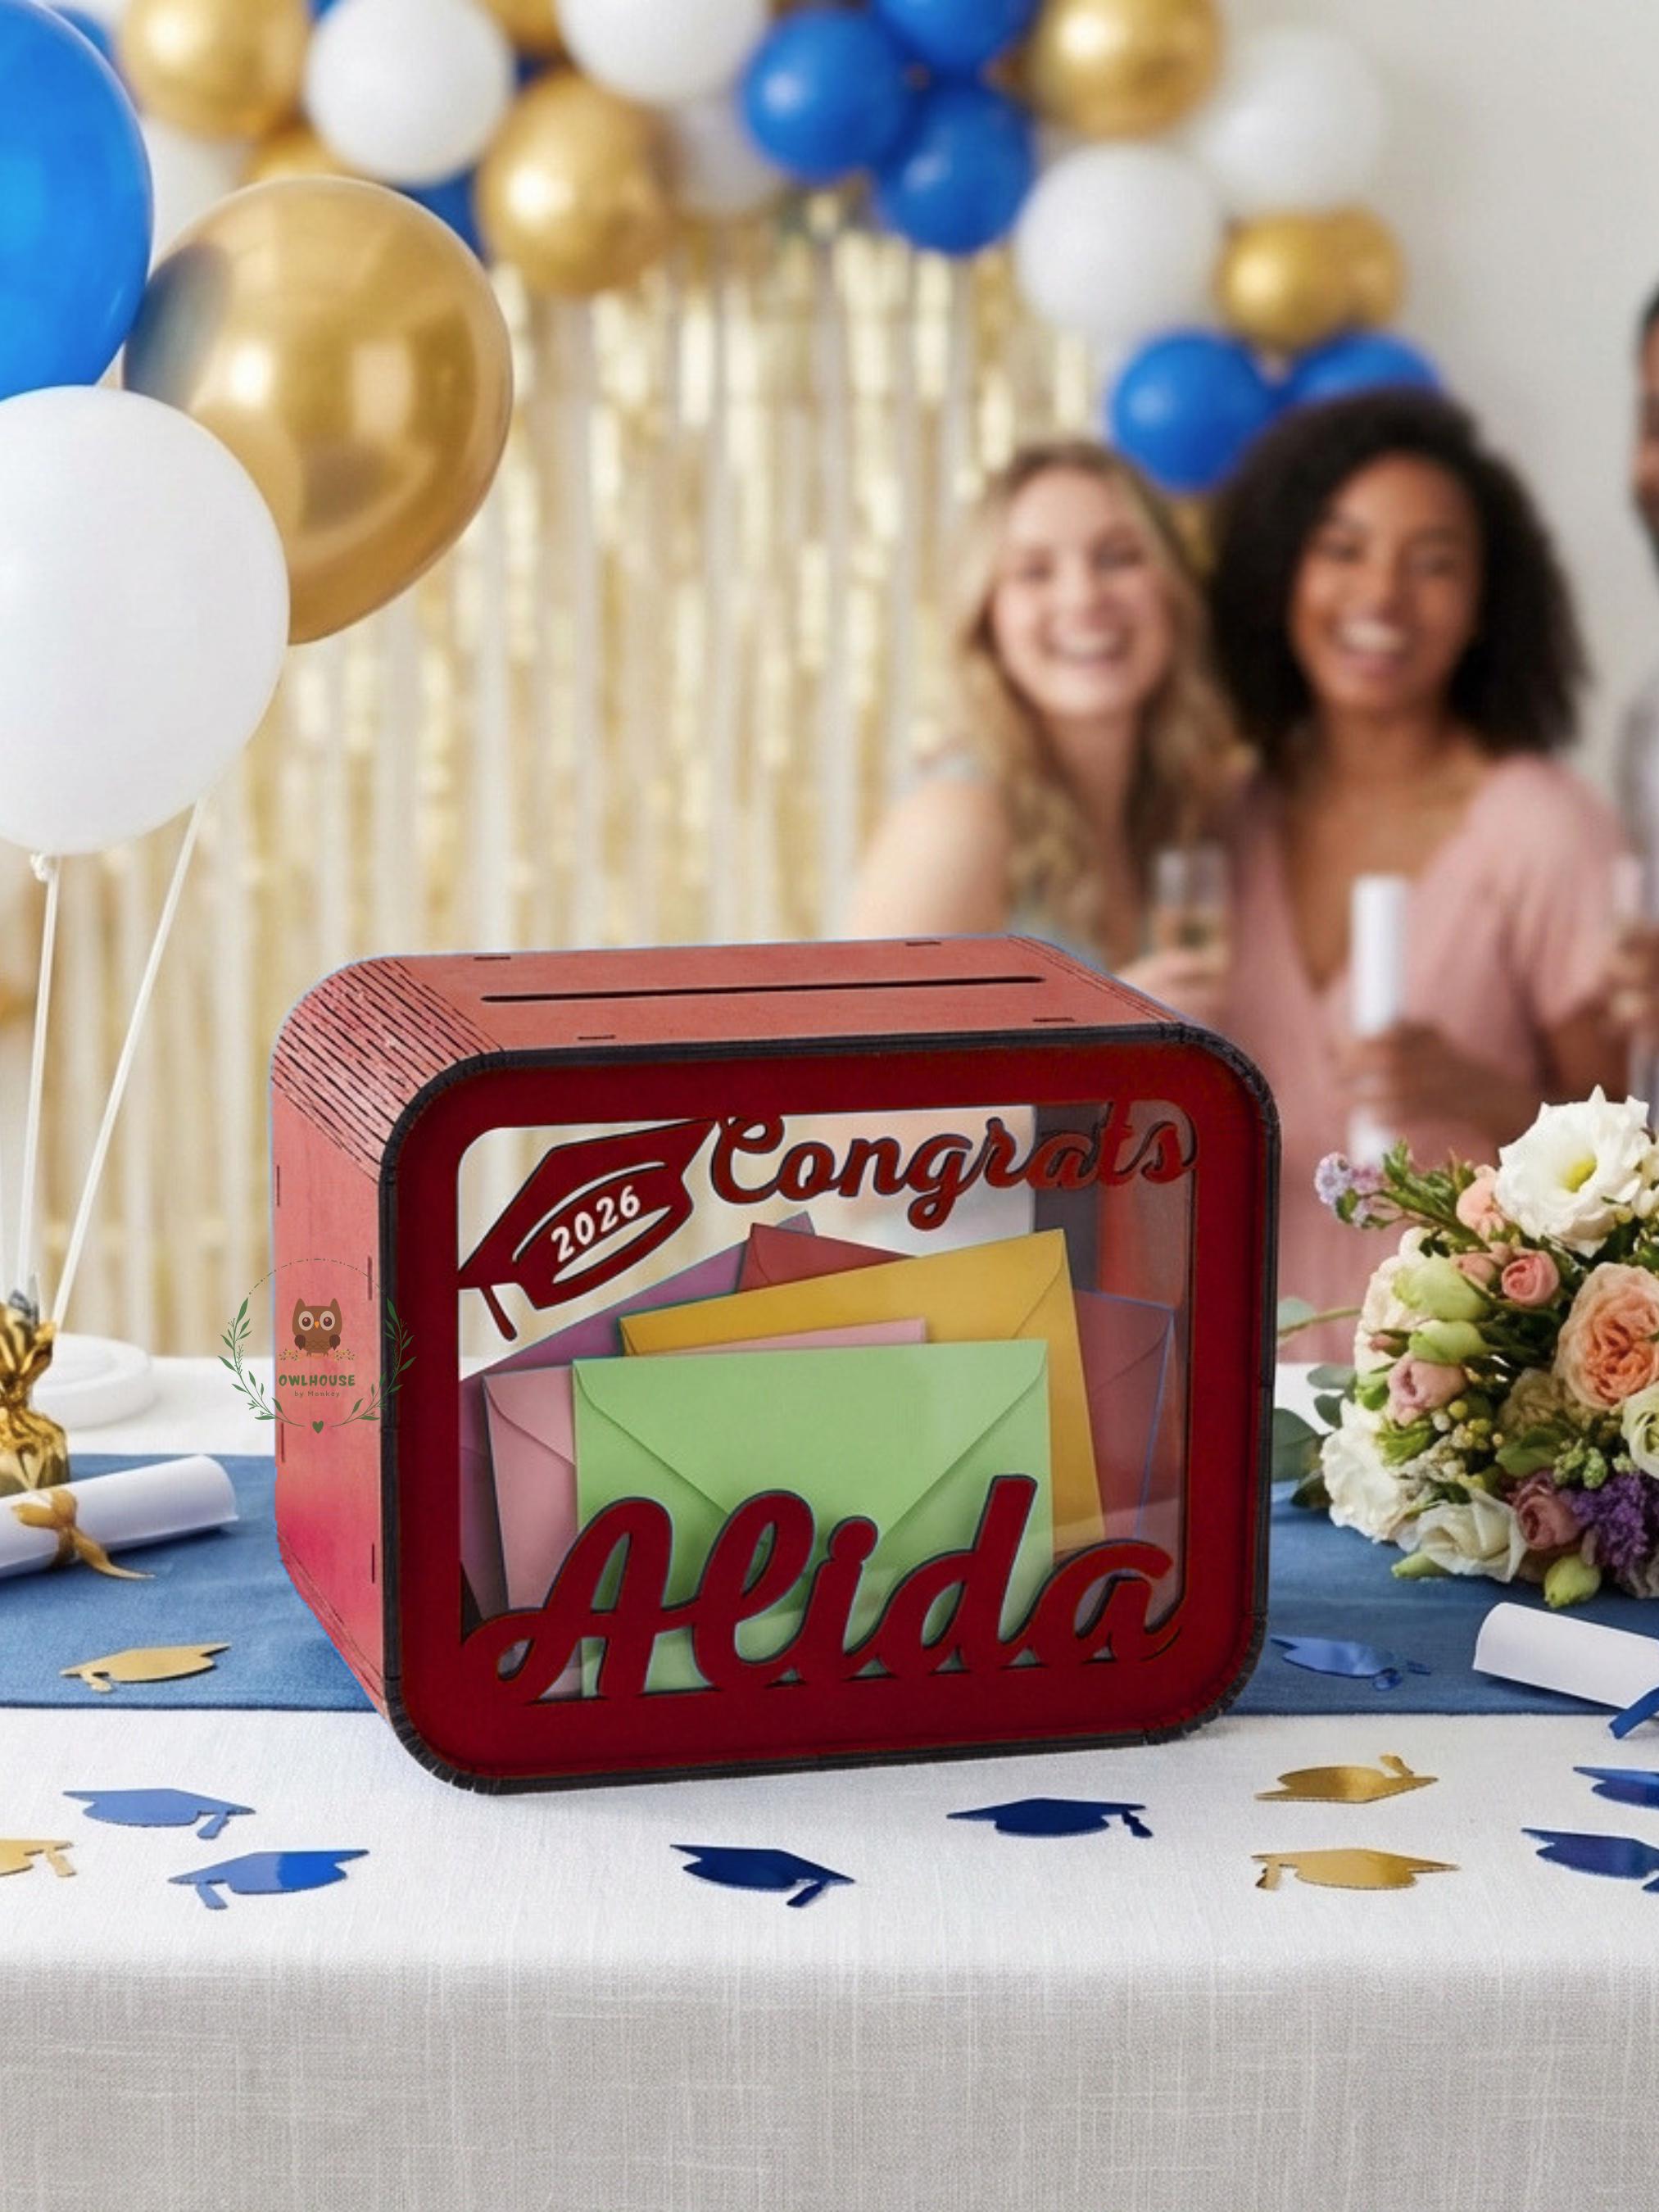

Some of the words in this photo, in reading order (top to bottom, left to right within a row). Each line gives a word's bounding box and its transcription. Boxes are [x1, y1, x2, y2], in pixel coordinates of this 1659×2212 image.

[551, 1185, 641, 1262] 2026
[709, 1099, 1193, 1231] Congrats
[464, 1473, 1178, 1702] Alida
